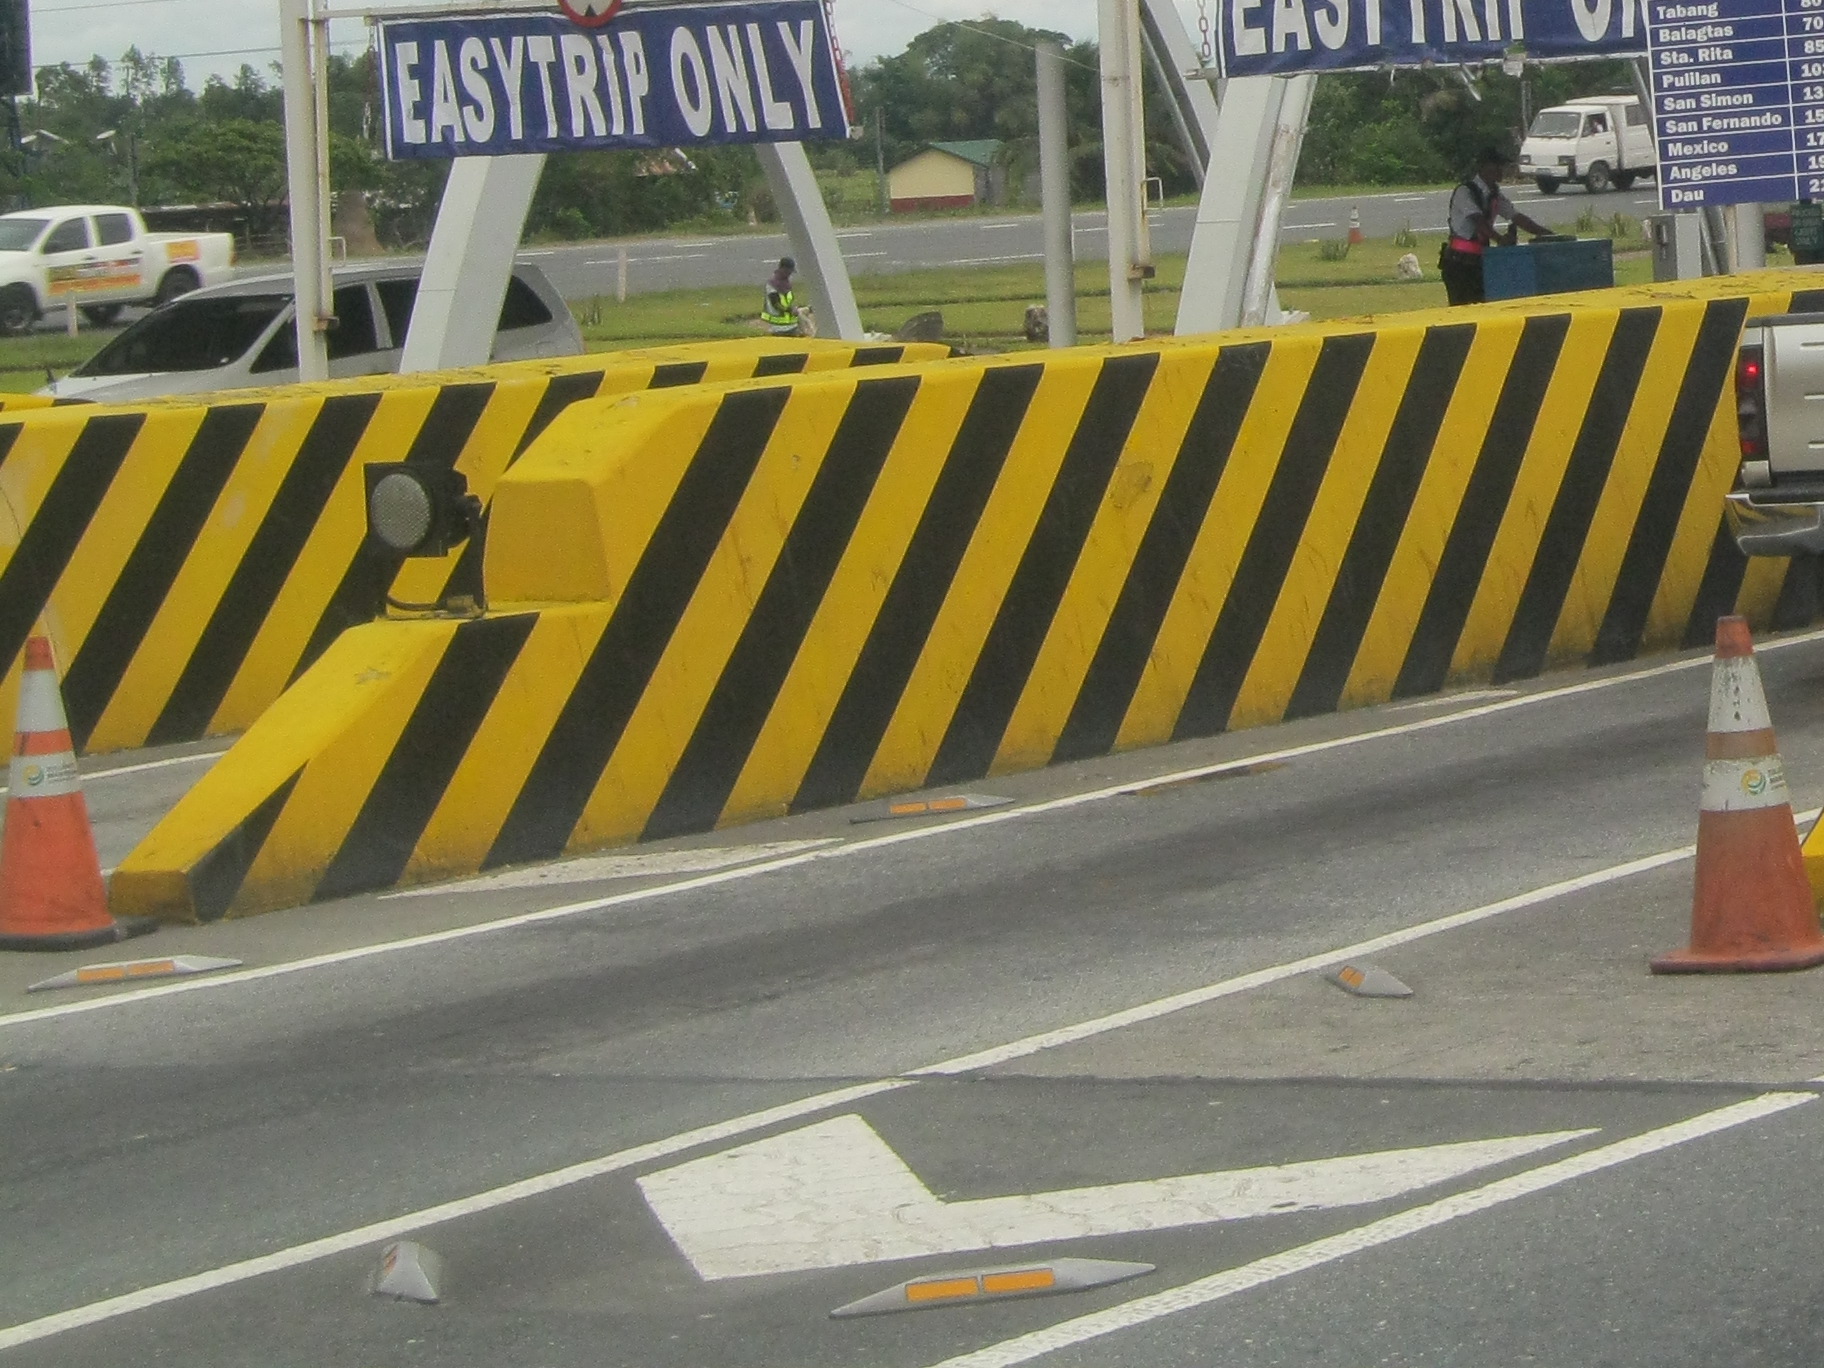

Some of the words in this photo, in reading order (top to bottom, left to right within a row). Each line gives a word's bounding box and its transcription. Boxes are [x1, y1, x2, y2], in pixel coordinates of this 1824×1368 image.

[1658, 3, 1718, 21] Tabang
[1659, 24, 1733, 43] Balagtas
[1803, 17, 1824, 30] 70
[1661, 51, 1694, 66] Sta.
[1699, 47, 1733, 62] Rita
[395, 32, 649, 144] EASYTRIP
[670, 19, 815, 137] ONLY
[1662, 71, 1721, 88] Pulilan
[1664, 97, 1696, 111] San
[1701, 91, 1753, 108] Simon
[1666, 119, 1699, 134] San
[1703, 113, 1782, 131] Fernando
[1668, 140, 1729, 156] Mexico
[1670, 163, 1738, 181] Angeles
[1671, 188, 1704, 203] Dau
